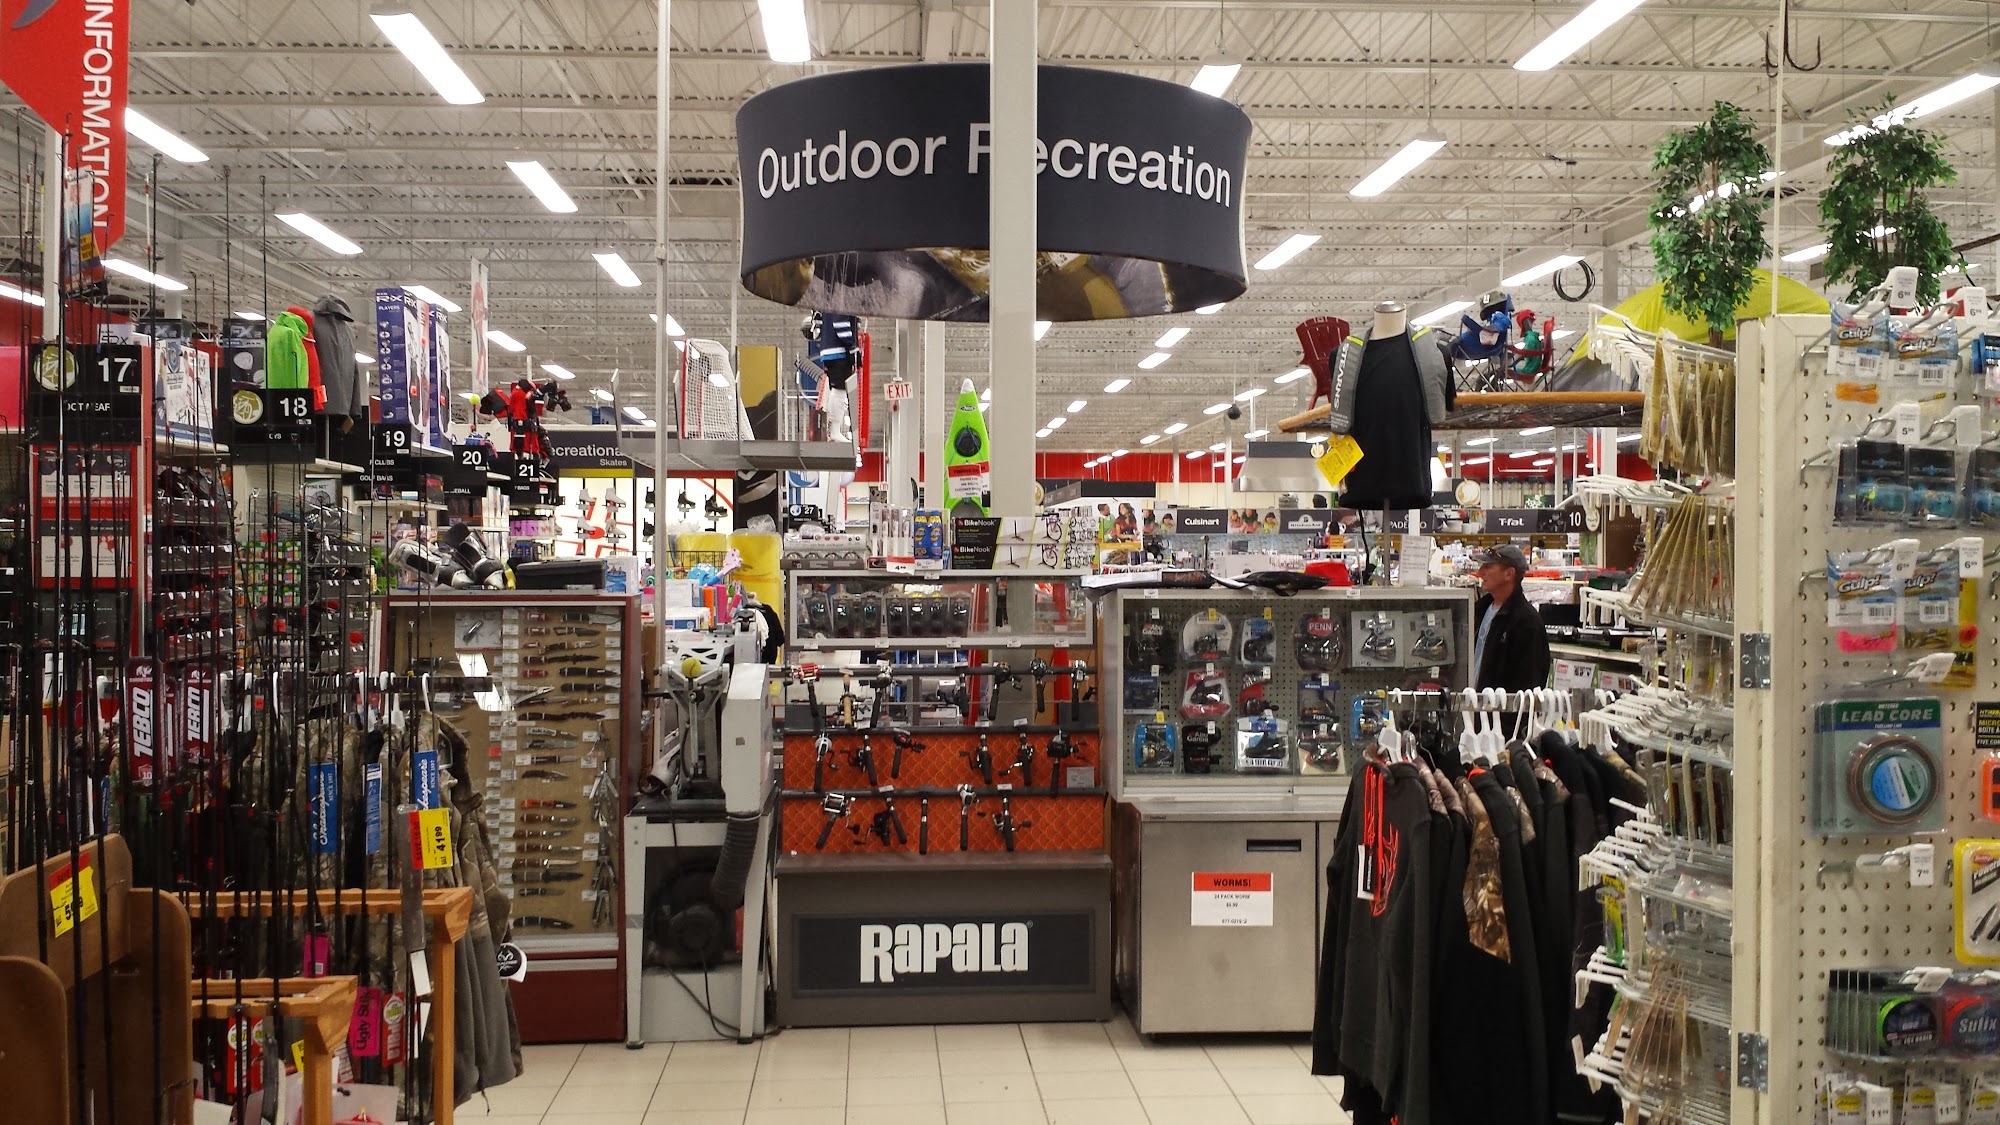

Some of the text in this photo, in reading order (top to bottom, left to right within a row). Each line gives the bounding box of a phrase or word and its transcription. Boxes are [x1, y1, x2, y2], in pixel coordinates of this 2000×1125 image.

[758, 129, 947, 200] Outdoor
[1838, 325, 1874, 341] Gulp!
[1898, 336, 1938, 353] Gulp!
[98, 357, 133, 382] 17
[887, 383, 910, 399] EXIT
[280, 397, 308, 417] 18
[383, 430, 406, 447] 19
[462, 451, 482, 465] 20
[550, 444, 623, 458] ecreationa
[599, 458, 628, 467] Skates
[519, 464, 534, 477] 21
[804, 506, 814, 515] 27
[964, 519, 994, 527] BikeNook
[1184, 517, 1220, 526] Cuisinart
[1389, 521, 1427, 529] PADEO
[1498, 517, 1525, 526] T-fal
[1569, 511, 1581, 527] 10
[960, 545, 991, 553] BikeNook
[1838, 574, 1882, 593] Gulp!
[1904, 572, 1938, 590] ulp!
[1308, 622, 1332, 631] PENN
[1841, 708, 1934, 722] LEAD CORE
[1213, 879, 1251, 887] WORMS!
[1958, 1017, 1998, 1033] Sufix
[355, 1020, 371, 1050] Ugly
